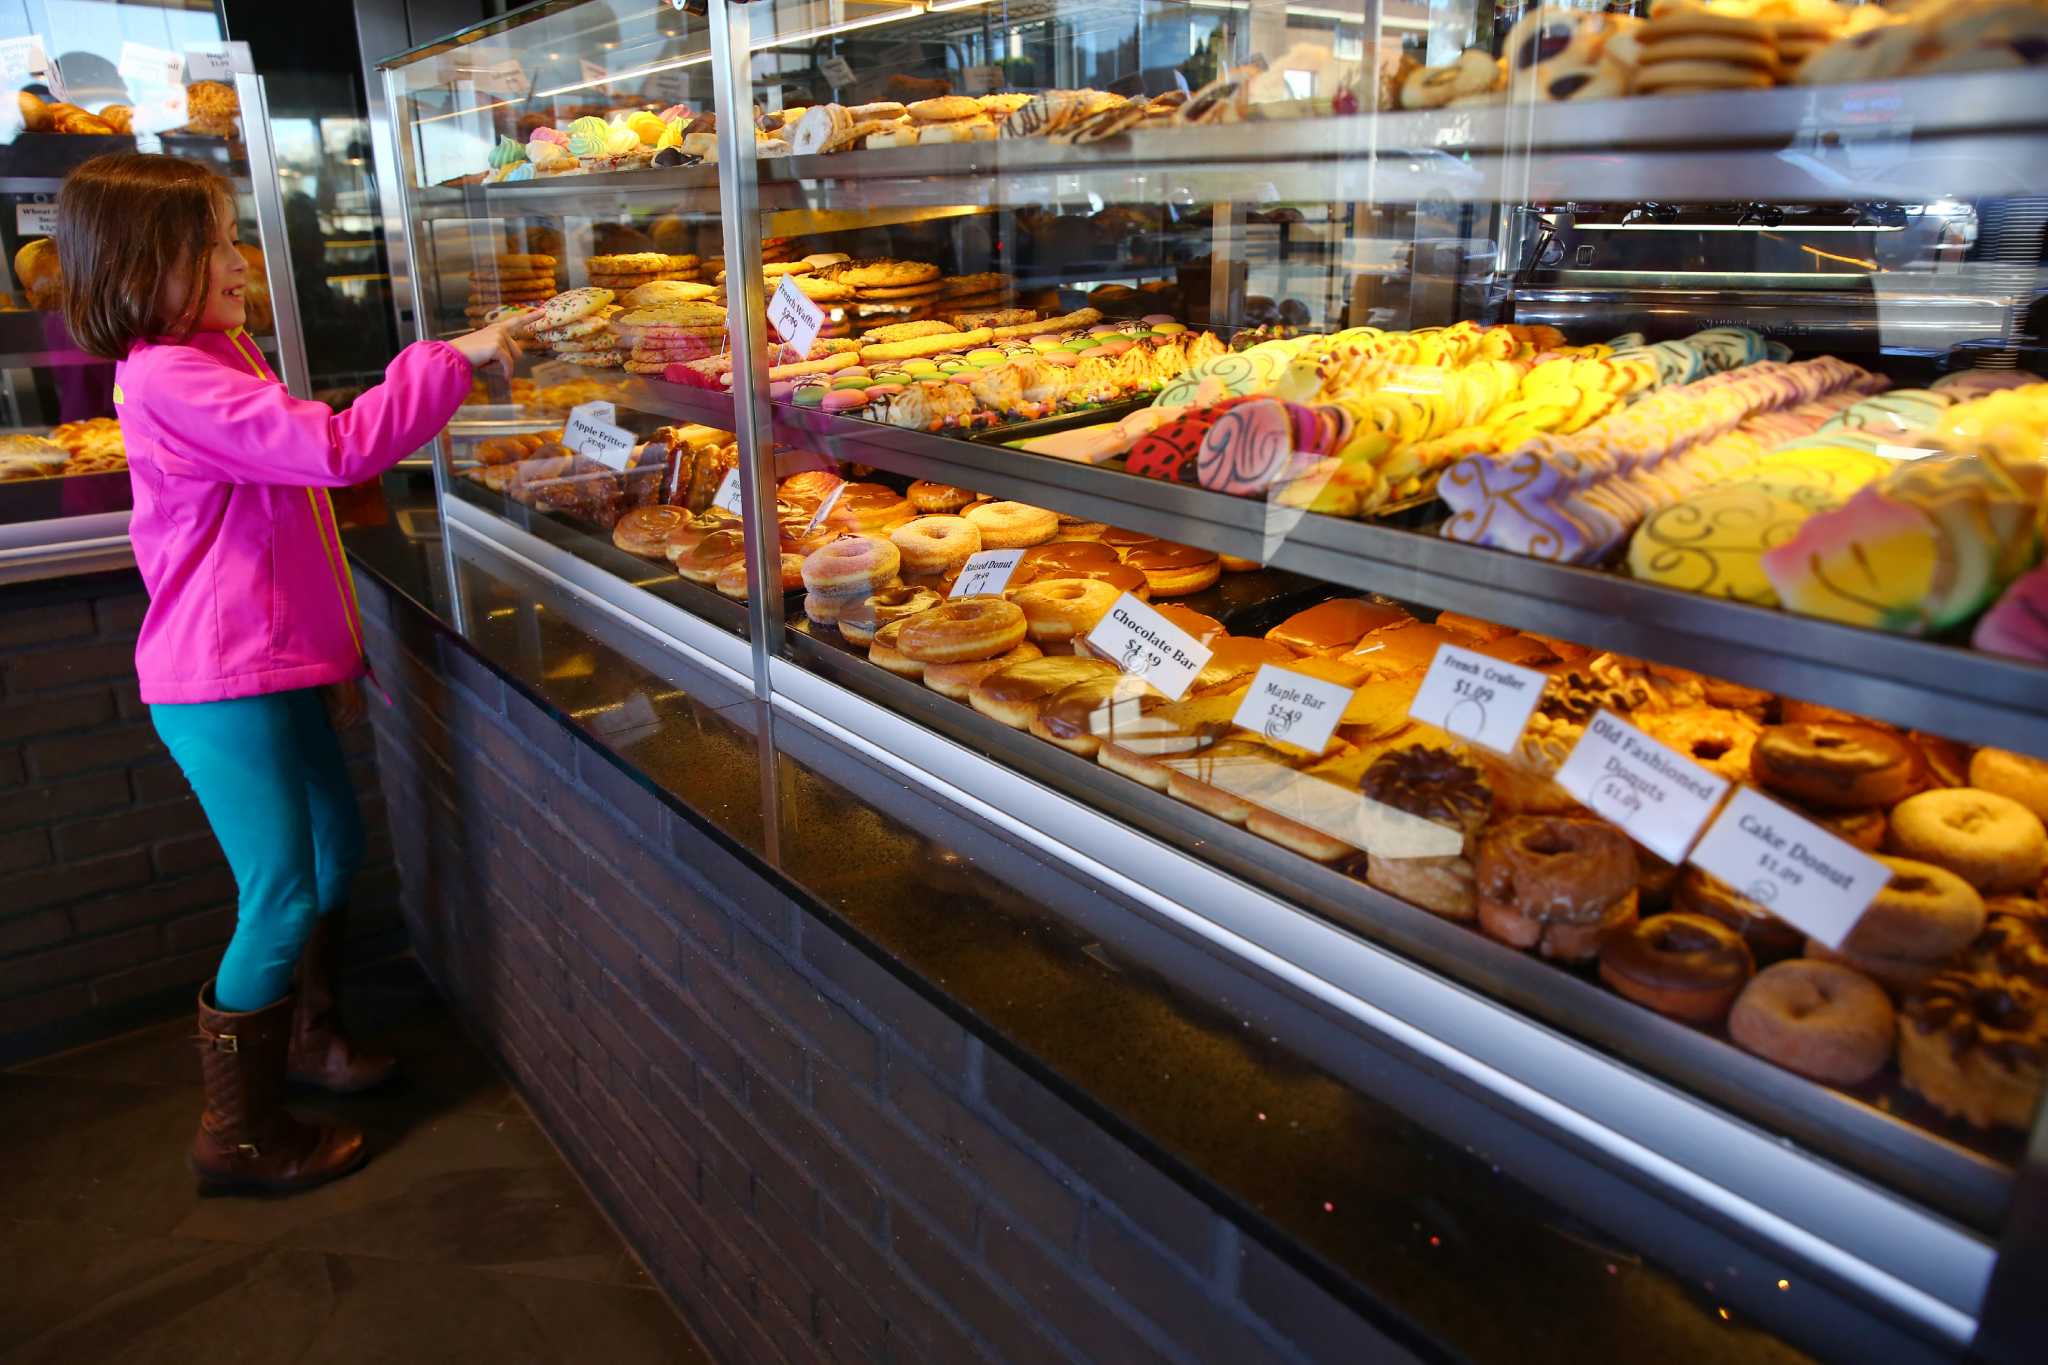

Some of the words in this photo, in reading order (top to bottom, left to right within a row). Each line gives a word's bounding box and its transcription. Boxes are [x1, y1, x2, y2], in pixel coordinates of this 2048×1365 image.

[779, 283, 796, 309] French
[796, 305, 816, 330] Waffle
[573, 420, 597, 435] Apple
[599, 432, 627, 448] Fritter
[965, 561, 989, 572] Raised
[988, 560, 1013, 569] Donut
[1113, 609, 1172, 653] Chocolate
[1172, 649, 1197, 671] Bar
[1125, 638, 1162, 667] $149
[1444, 655, 1479, 675] French
[1484, 667, 1526, 690] Cruller
[1264, 683, 1300, 702] Maple
[1301, 693, 1327, 710] Bar
[1453, 678, 1495, 702] $1.09
[1592, 719, 1623, 745] Old
[1621, 737, 1715, 800] Fashioned
[1604, 755, 1665, 802] Donuts
[1604, 783, 1642, 811] $1.09
[1738, 814, 1787, 849] Cake
[1788, 842, 1855, 890] Donut
[1758, 853, 1803, 885] $1.09
